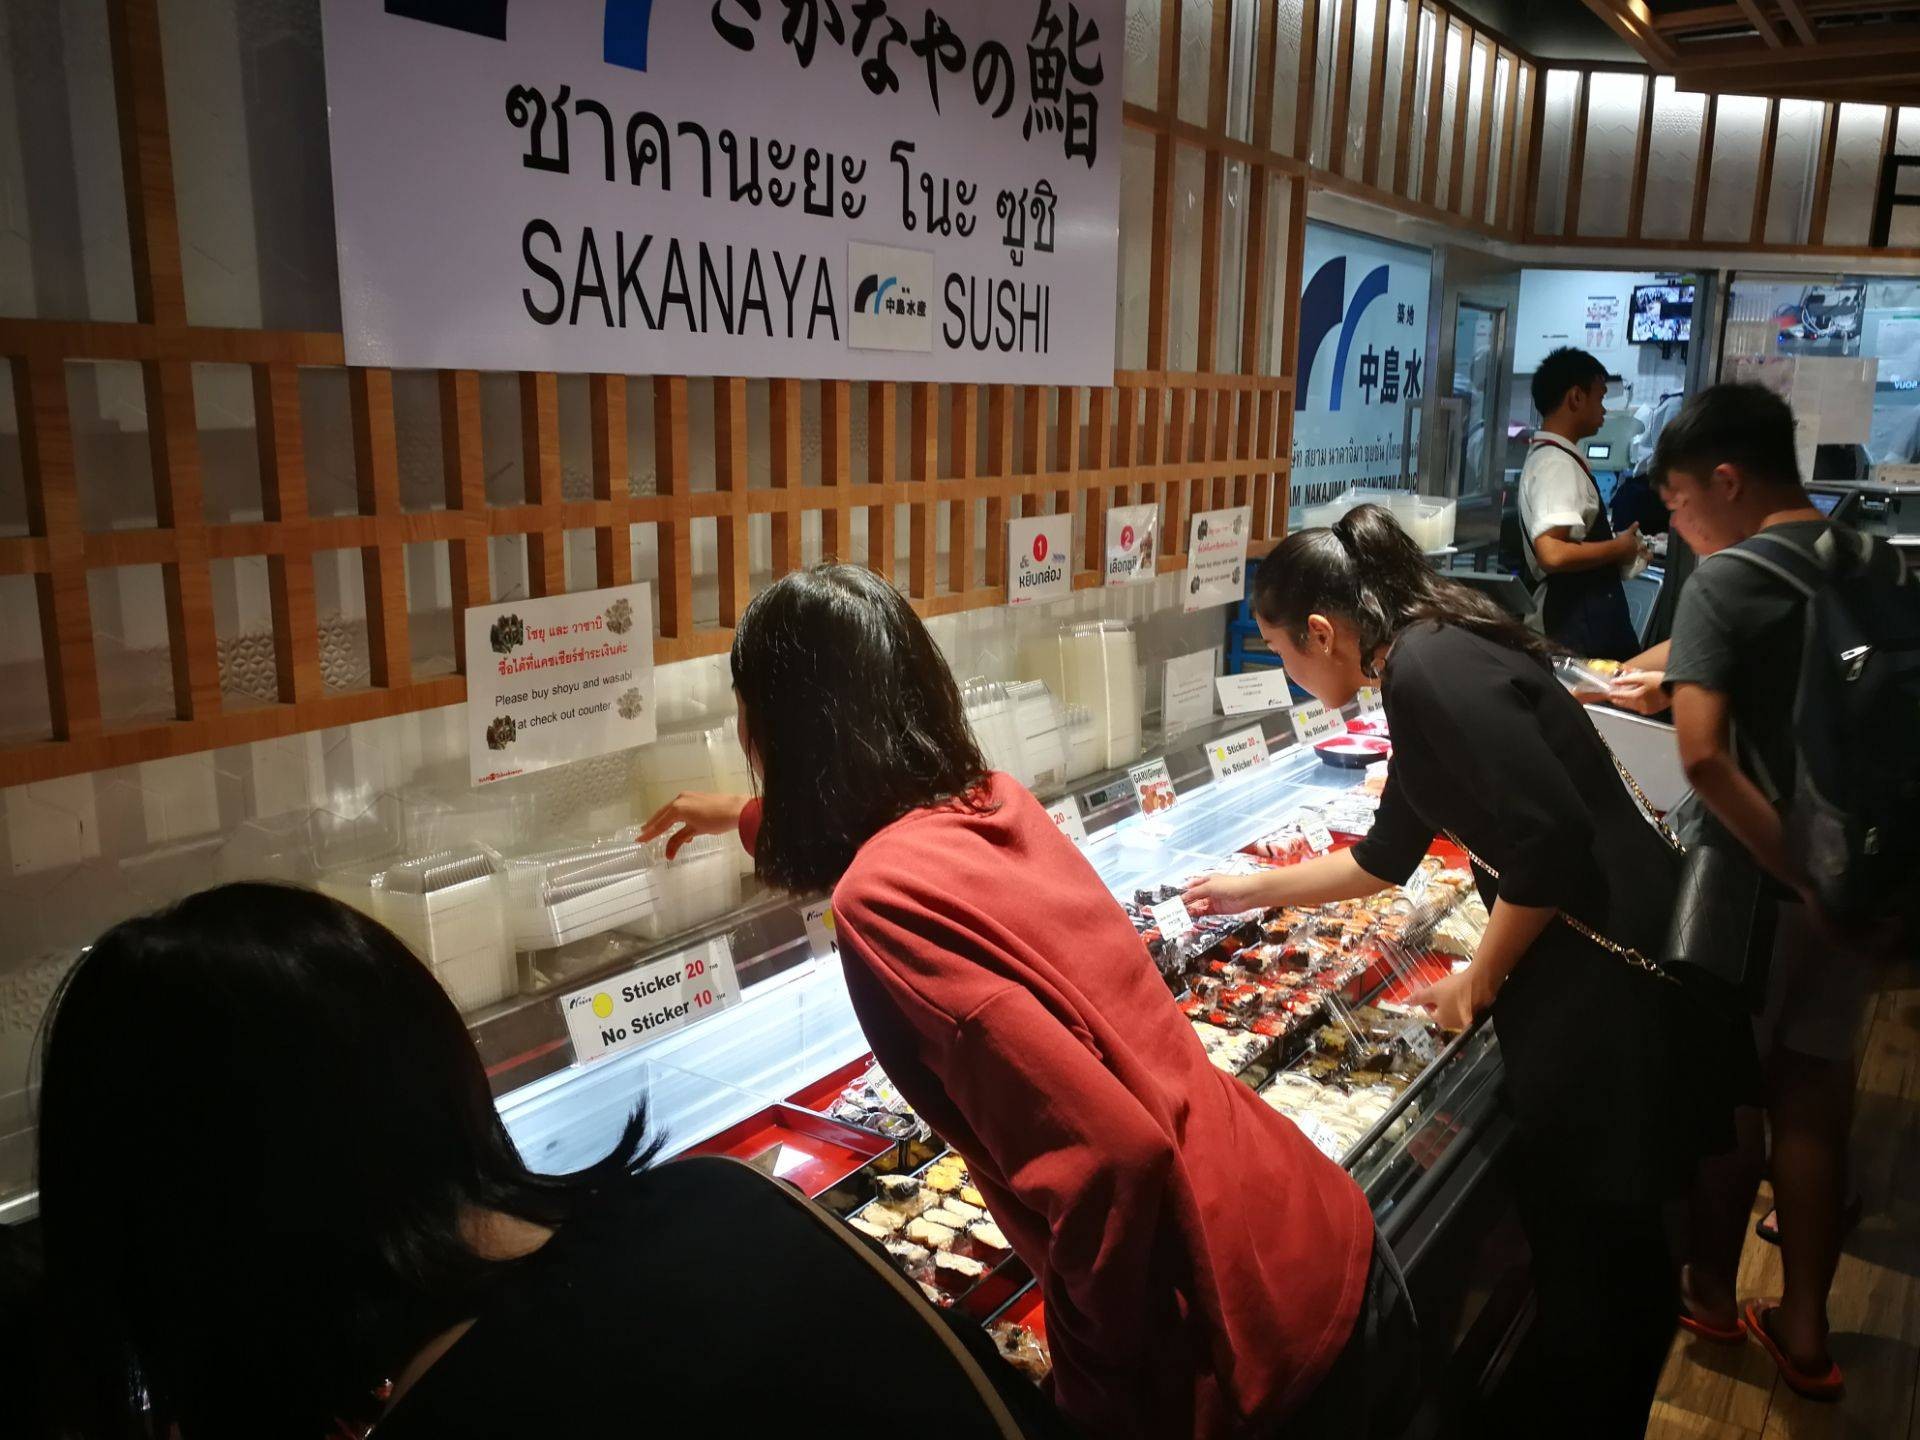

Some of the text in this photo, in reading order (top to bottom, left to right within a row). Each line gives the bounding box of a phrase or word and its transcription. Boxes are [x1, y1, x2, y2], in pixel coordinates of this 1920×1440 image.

[505, 83, 1058, 267] ซาคานะยะ โนะ ซูชิ
[521, 218, 1049, 354] SAKANAYA SUSHI
[495, 670, 633, 707] Please buy shoyu and wasabi
[517, 702, 612, 730] at check out counter
[1226, 740, 1248, 755] Sticker
[1222, 766, 1232, 777] No
[1232, 759, 1253, 773] Sticker
[1054, 812, 1065, 825] 20
[621, 969, 682, 1004] Sticker
[685, 960, 704, 979] 20
[601, 1028, 627, 1047] No
[631, 1000, 690, 1034] Sticker
[694, 989, 712, 1008] 10
